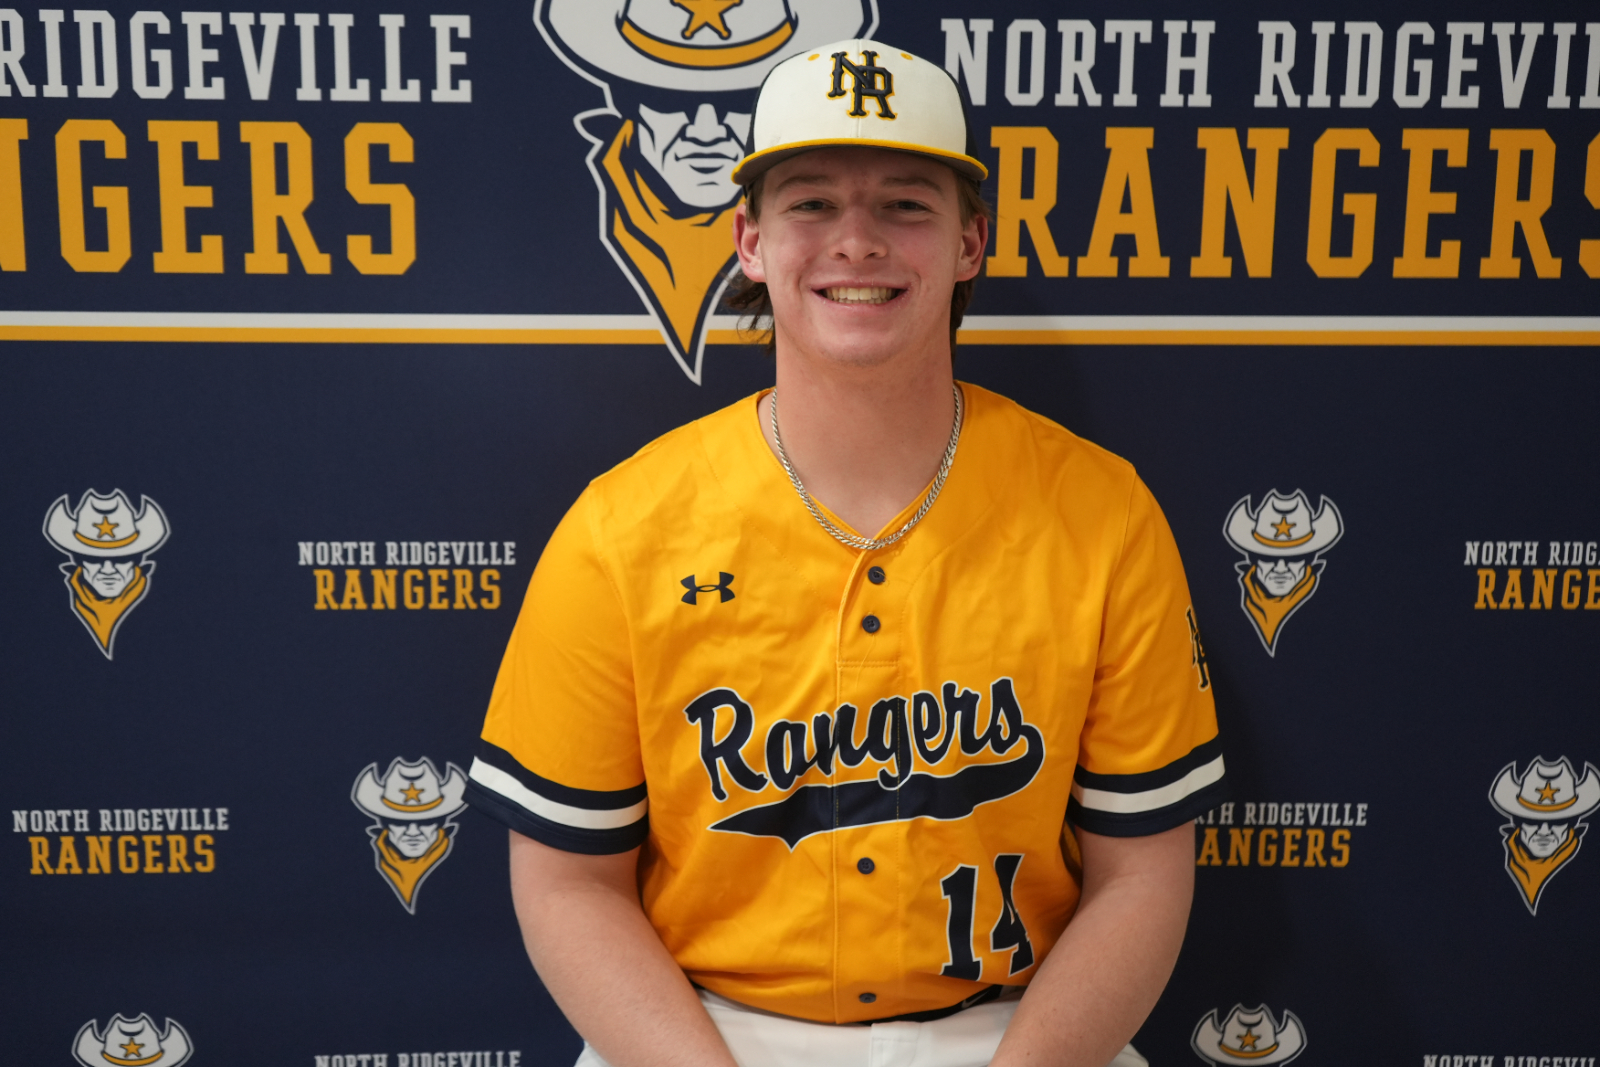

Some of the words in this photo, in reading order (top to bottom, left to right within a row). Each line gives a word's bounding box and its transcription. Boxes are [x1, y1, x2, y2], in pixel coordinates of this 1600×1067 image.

[0, 8, 472, 103] RIDGEVILLE
[941, 18, 1216, 108] NORTH
[298, 541, 376, 566] NORTH
[385, 541, 516, 566] RIDGEVILLE
[1464, 541, 1539, 566] NORTH
[1548, 541, 1600, 566] RIDG
[313, 568, 501, 610] RANGERS
[683, 676, 1030, 802] Rangers
[12, 809, 90, 832] NORTH
[99, 808, 229, 832] RIDGEVILLE
[1243, 802, 1368, 826] RIDGEVILLE
[28, 834, 216, 875] RANGERS
[1196, 827, 1351, 868] ANGERS
[939, 853, 1035, 982] 14
